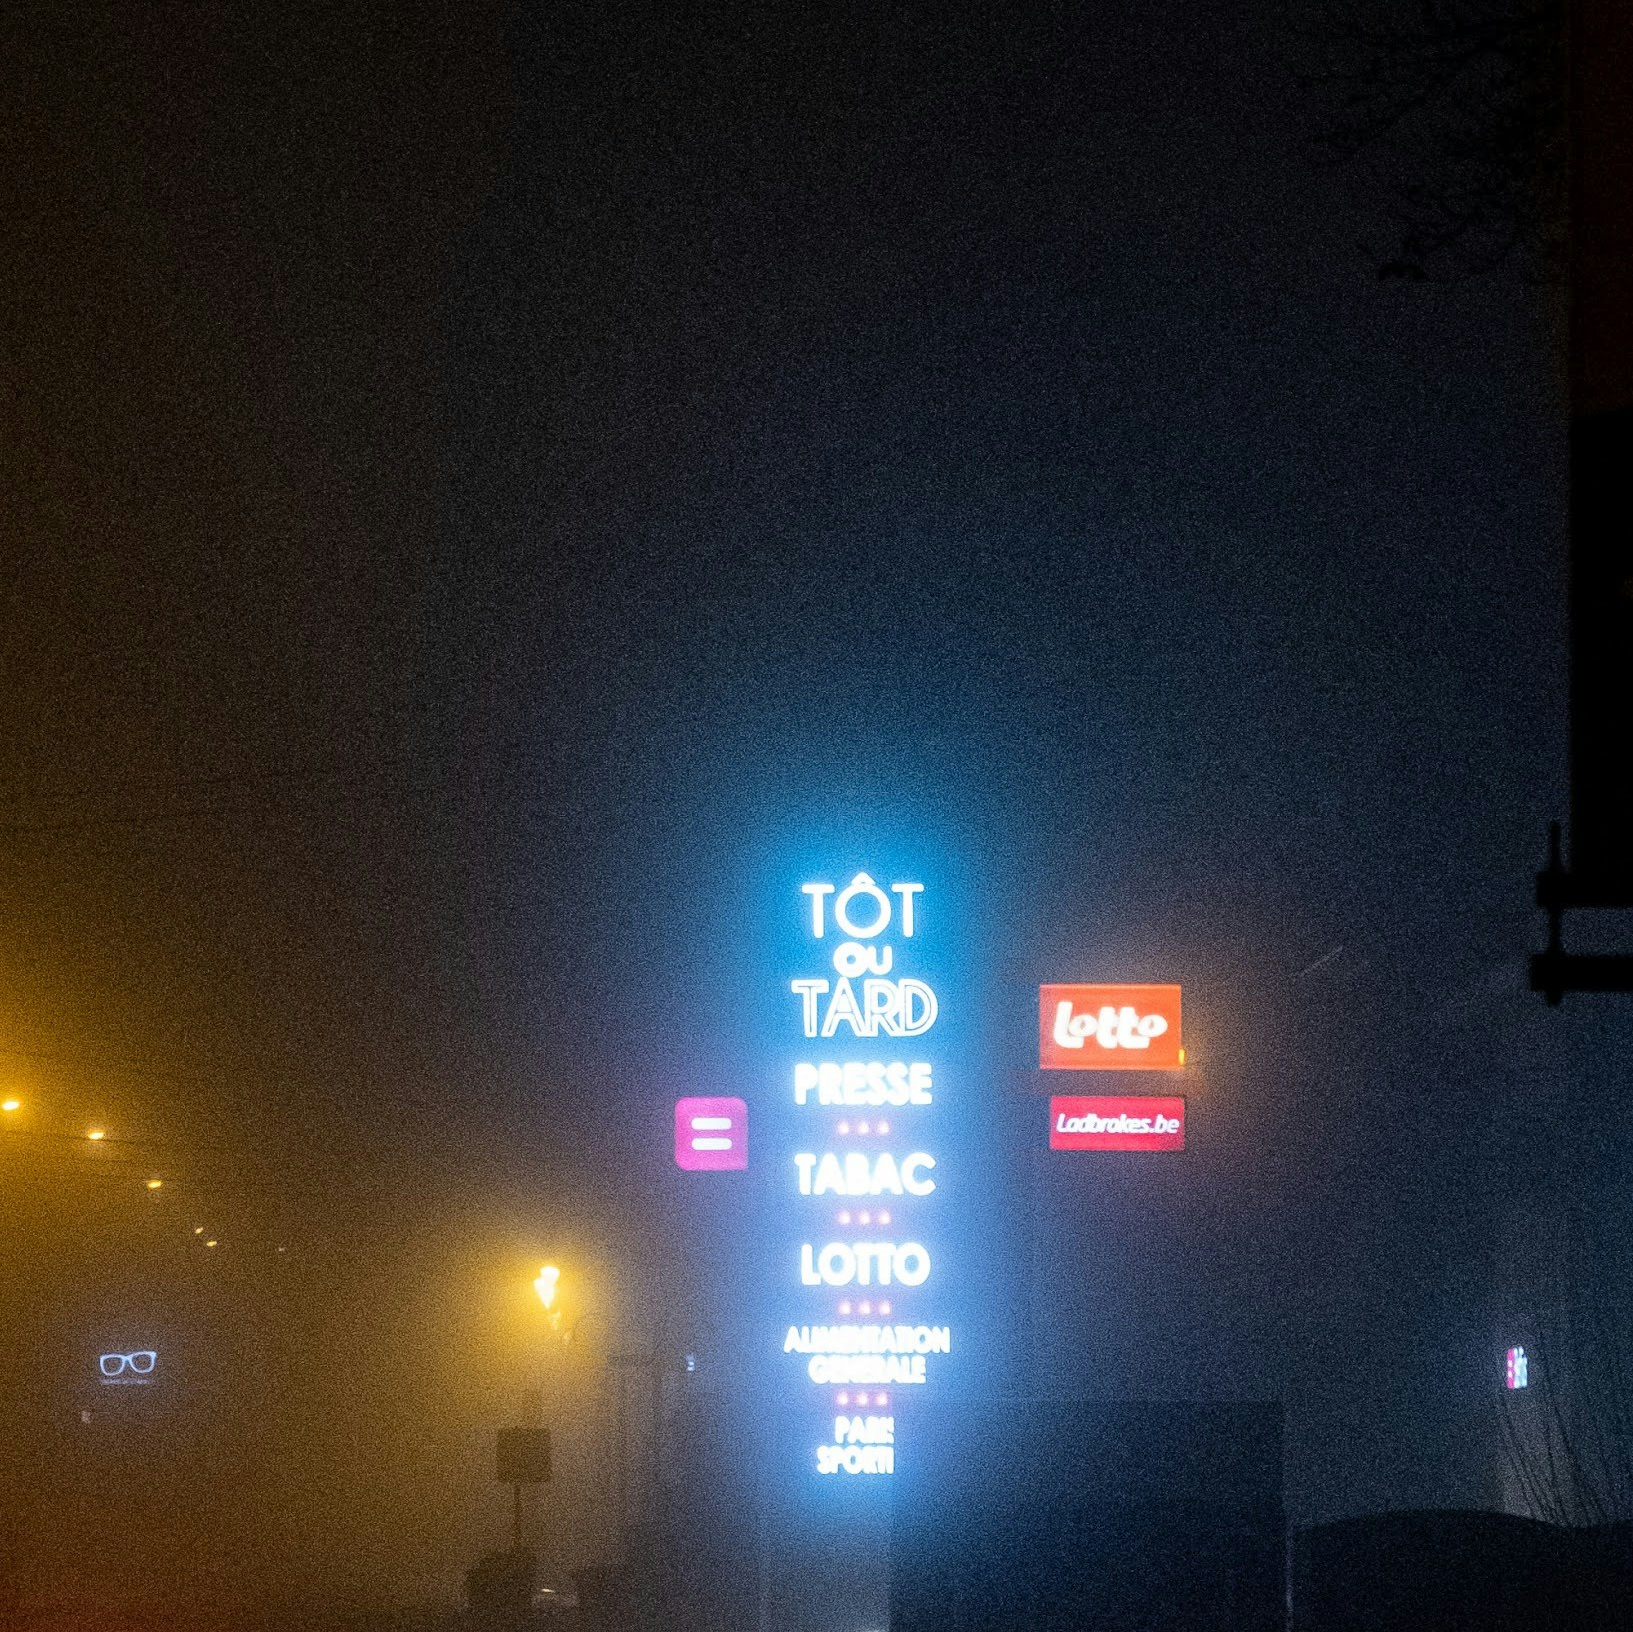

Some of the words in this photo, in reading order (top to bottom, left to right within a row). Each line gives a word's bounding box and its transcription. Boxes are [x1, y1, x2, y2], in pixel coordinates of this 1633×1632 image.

[803, 873, 922, 937] TÔT
[792, 979, 937, 1036] TARD
[795, 1062, 931, 1105] PRESSE
[1057, 1114, 1179, 1133] Ladbrokes.be
[795, 1152, 935, 1195] TABAC
[801, 1242, 930, 1286] LOTTO
[784, 1325, 949, 1354] ALIMENTATION
